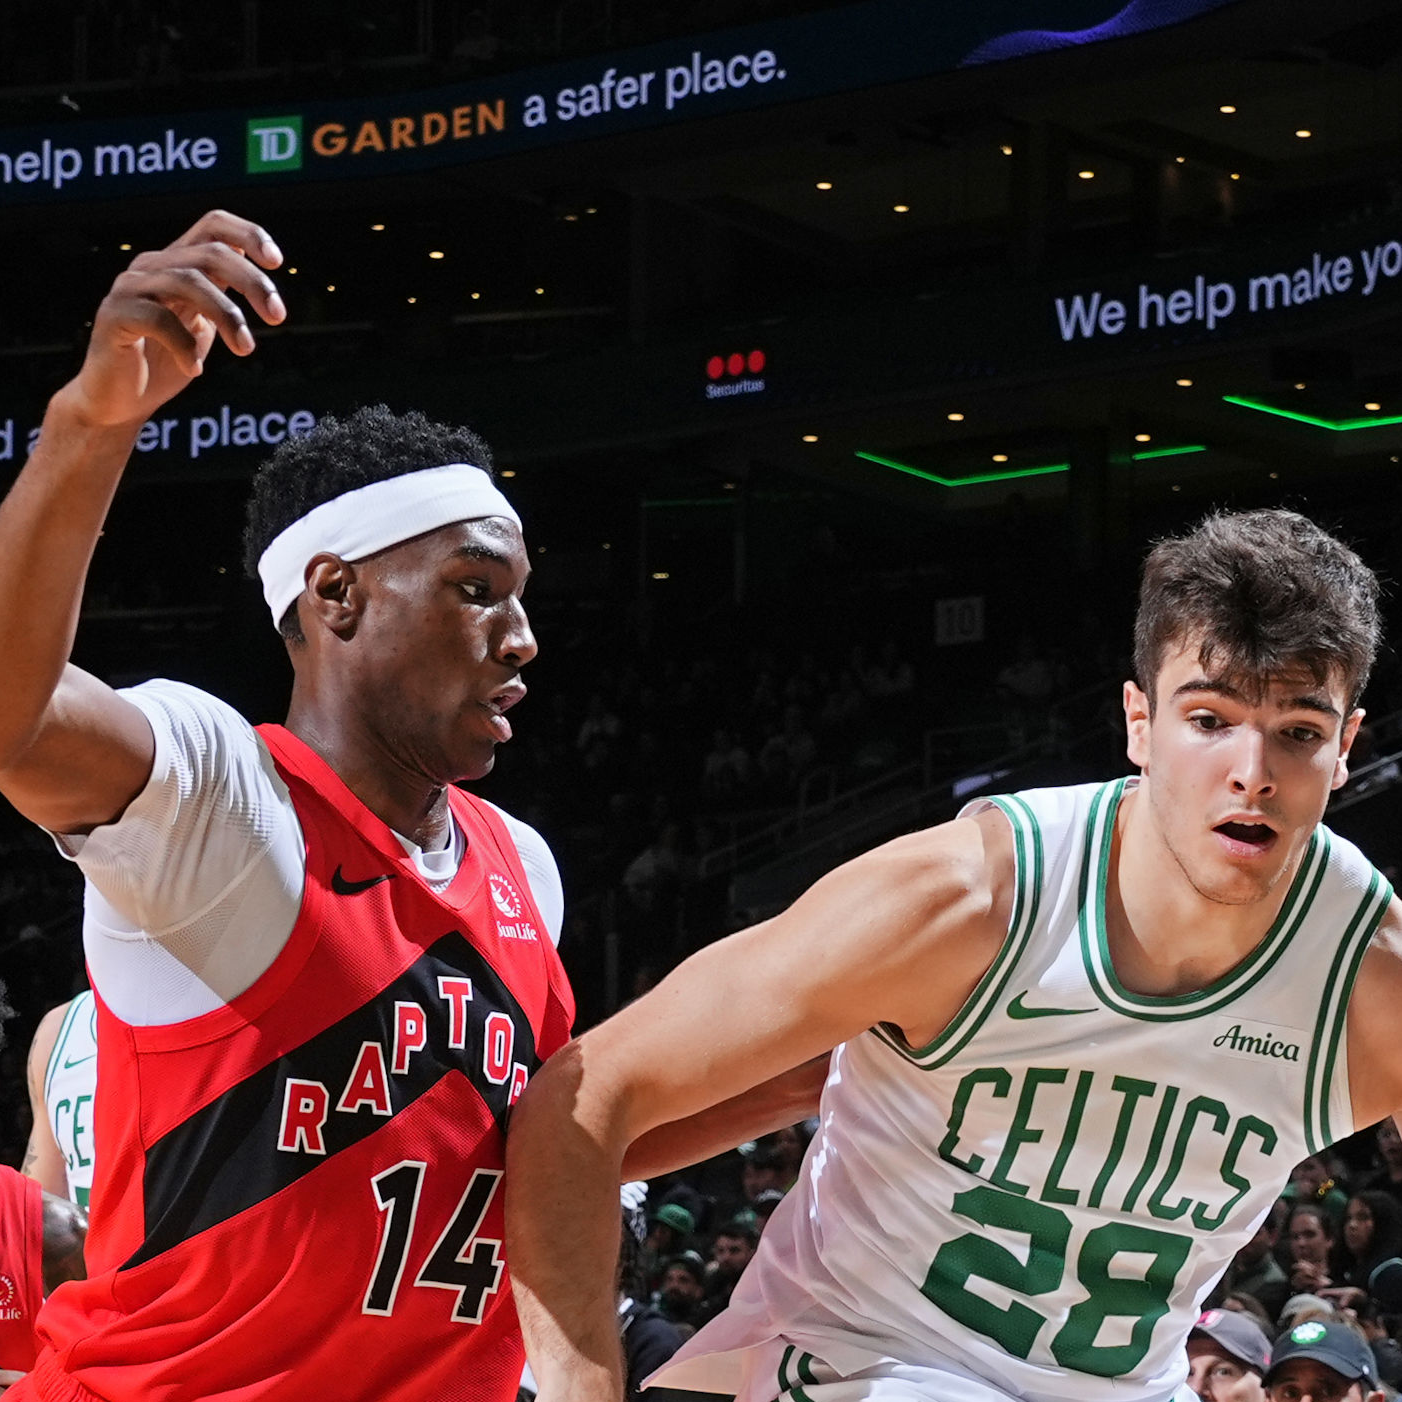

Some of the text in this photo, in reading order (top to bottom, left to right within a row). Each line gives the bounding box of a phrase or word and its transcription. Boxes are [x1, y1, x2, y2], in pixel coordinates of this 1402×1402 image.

[94, 130, 217, 174] make
[253, 126, 298, 162] TD
[312, 99, 505, 157] GARDEN
[523, 94, 547, 128] a
[556, 68, 656, 122] safer
[666, 49, 788, 110] place.
[1055, 291, 1126, 341] We
[1138, 275, 1236, 329] help
[1249, 252, 1354, 312] make
[496, 920, 538, 941] Sun Life
[278, 975, 528, 1156] RAPTO
[1213, 1024, 1300, 1062] Amica
[938, 1066, 1279, 1231] CELTICS
[361, 1160, 505, 1325] 14
[919, 1184, 1194, 1378] 28
[0, 1307, 22, 1321] Life
